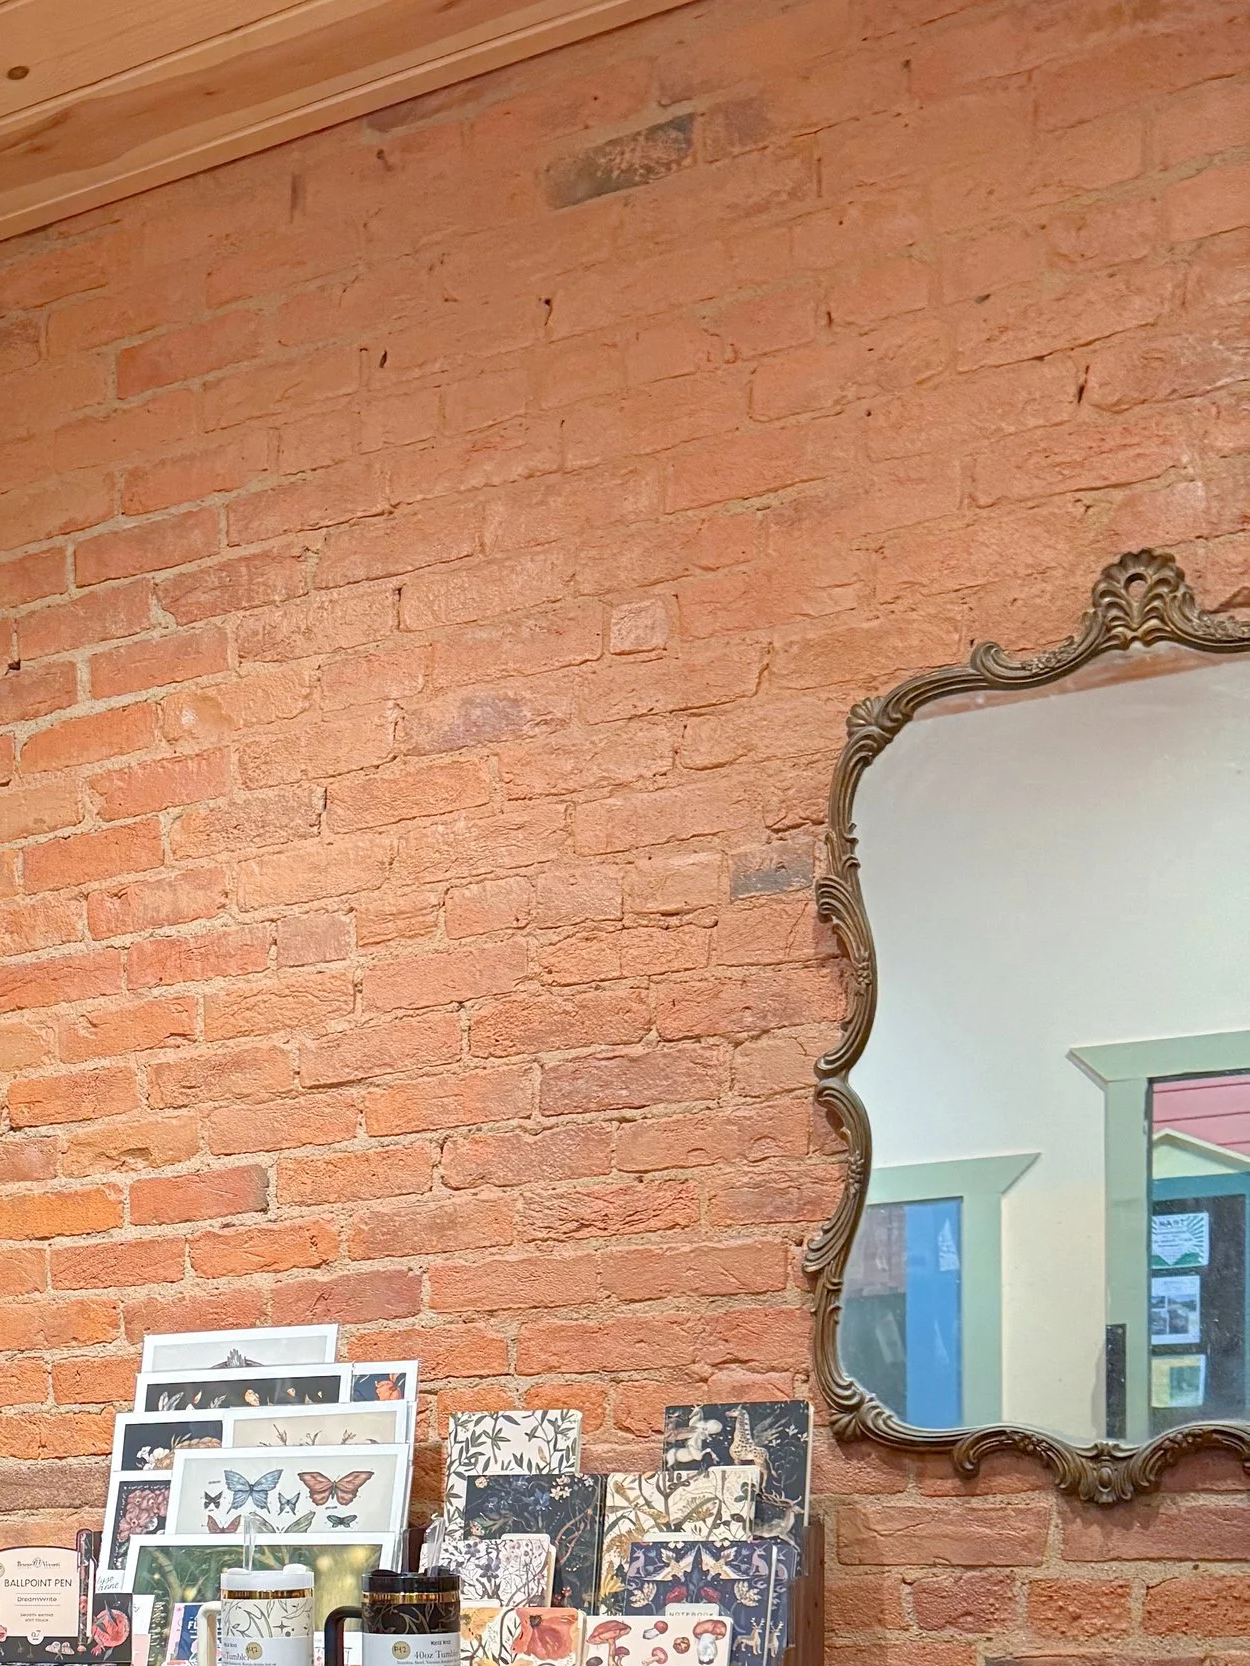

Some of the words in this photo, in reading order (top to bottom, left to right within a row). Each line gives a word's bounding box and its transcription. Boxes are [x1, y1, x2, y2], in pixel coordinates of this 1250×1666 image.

[4, 1579, 52, 1588] BALLPOINT
[54, 1579, 72, 1587] PEN
[414, 1650, 434, 1660] 40oz
